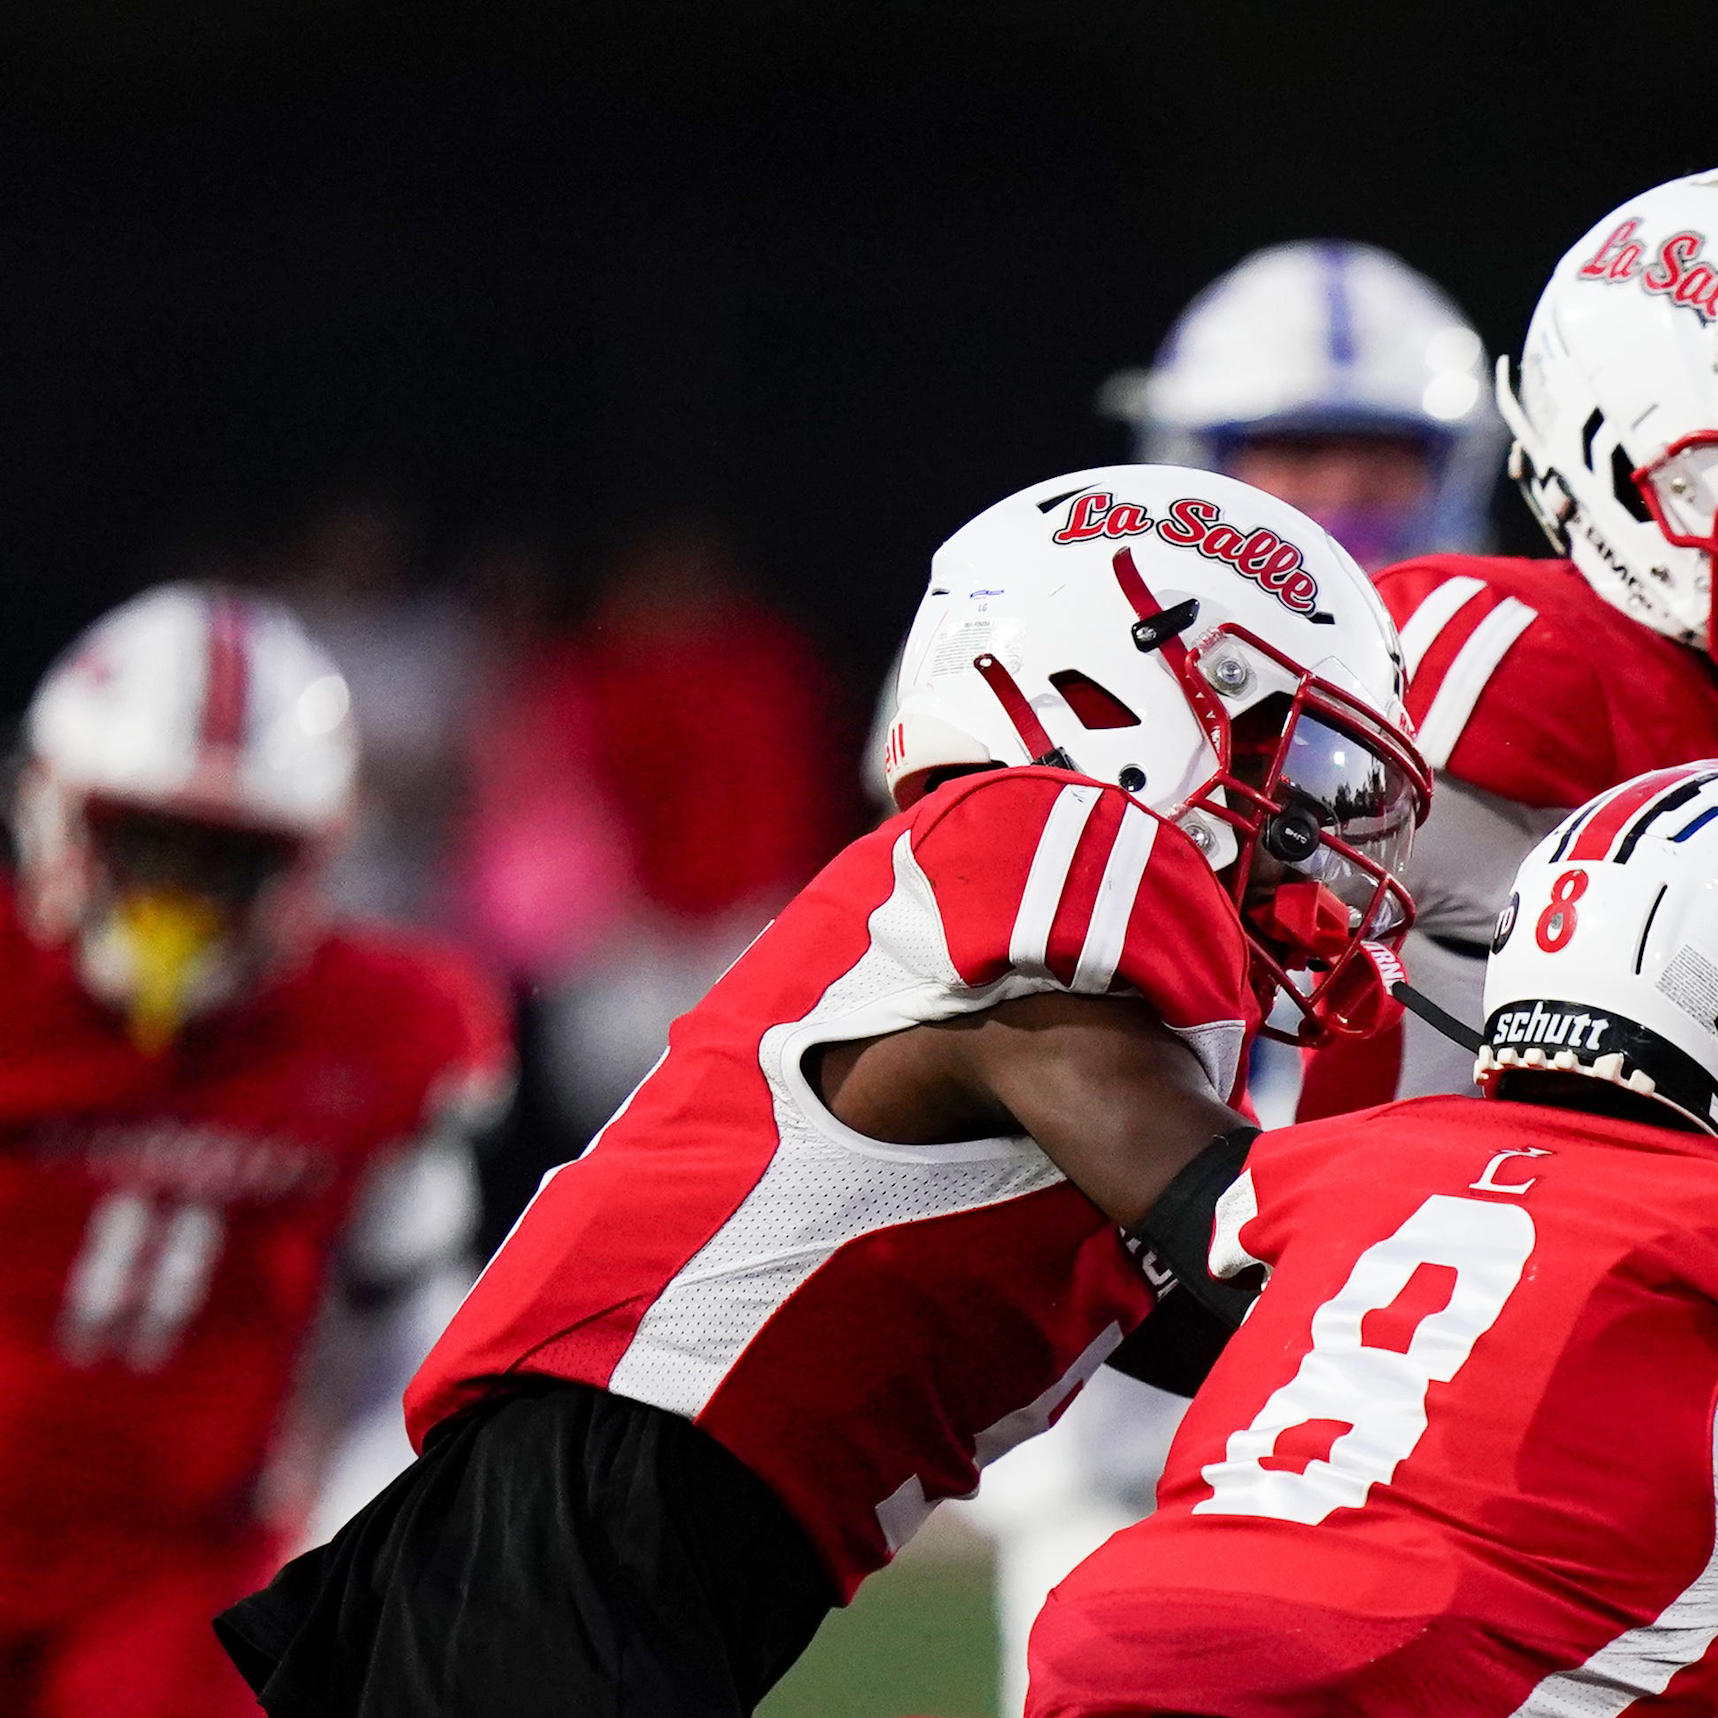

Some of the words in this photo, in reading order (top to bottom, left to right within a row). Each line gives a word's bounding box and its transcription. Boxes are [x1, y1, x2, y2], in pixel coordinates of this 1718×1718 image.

[1579, 217, 1646, 283] La
[1053, 491, 1153, 545] La
[1156, 497, 1318, 615] Salle
[1535, 868, 1590, 954] 8
[1493, 1001, 1609, 1051] schutt
[1191, 1193, 1537, 1527] 8
